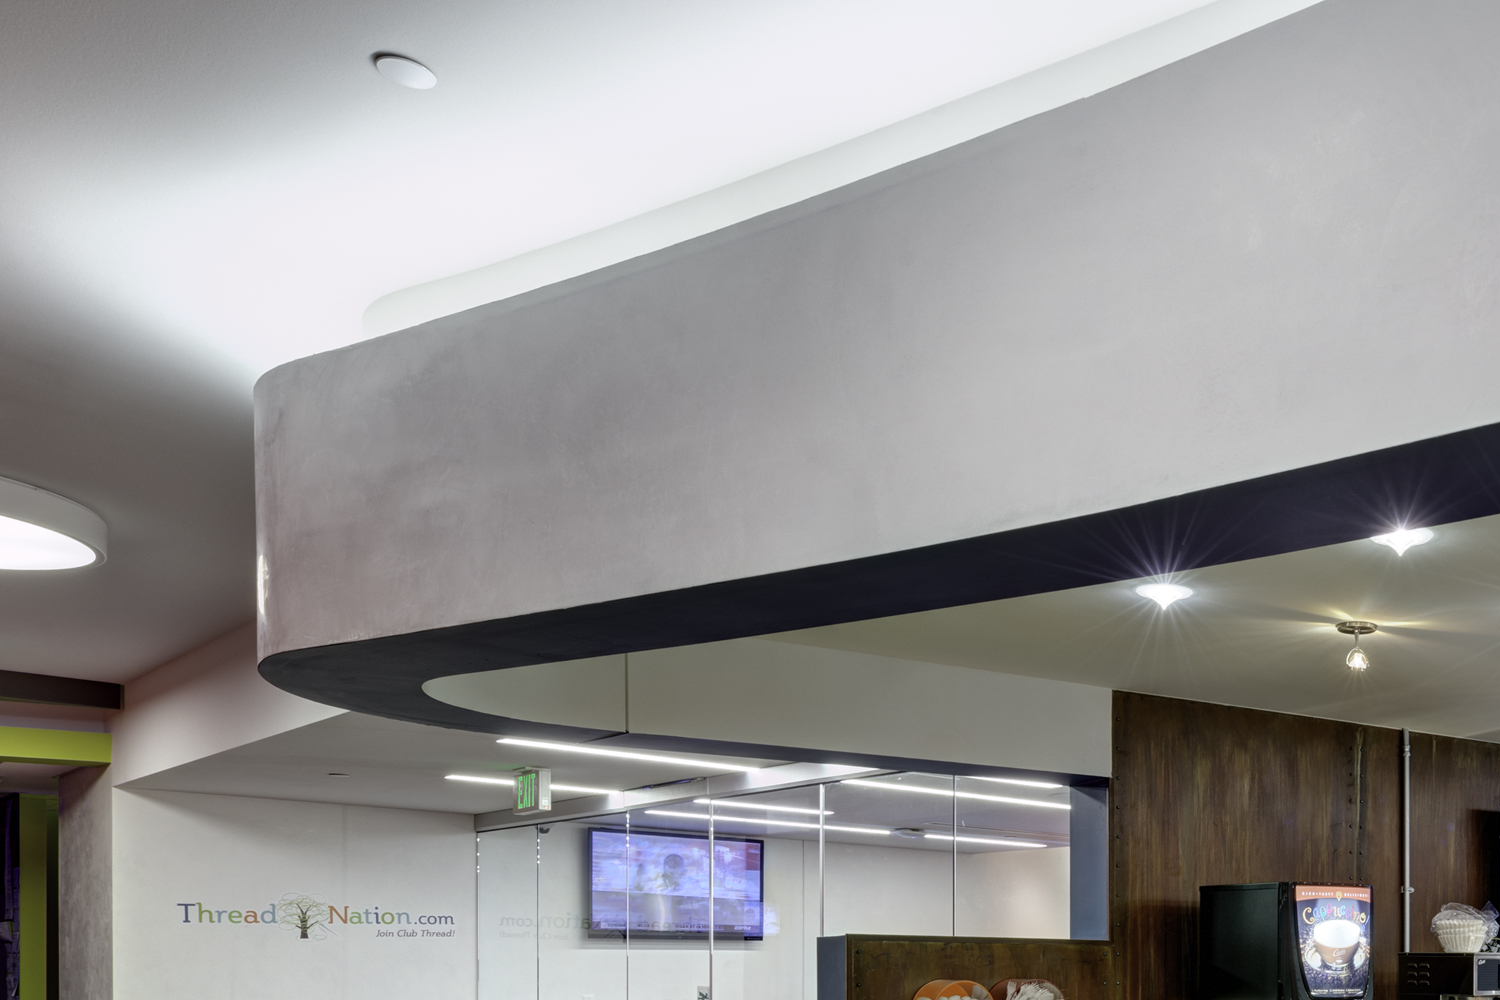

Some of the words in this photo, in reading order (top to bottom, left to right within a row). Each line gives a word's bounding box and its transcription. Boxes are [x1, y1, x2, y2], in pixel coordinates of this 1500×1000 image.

[518, 773, 535, 809] EXIT
[177, 902, 278, 924] Thread
[327, 905, 456, 925] Nation.com
[375, 929, 394, 938] Join
[397, 929, 417, 938] Club
[420, 929, 456, 938] Thread!
